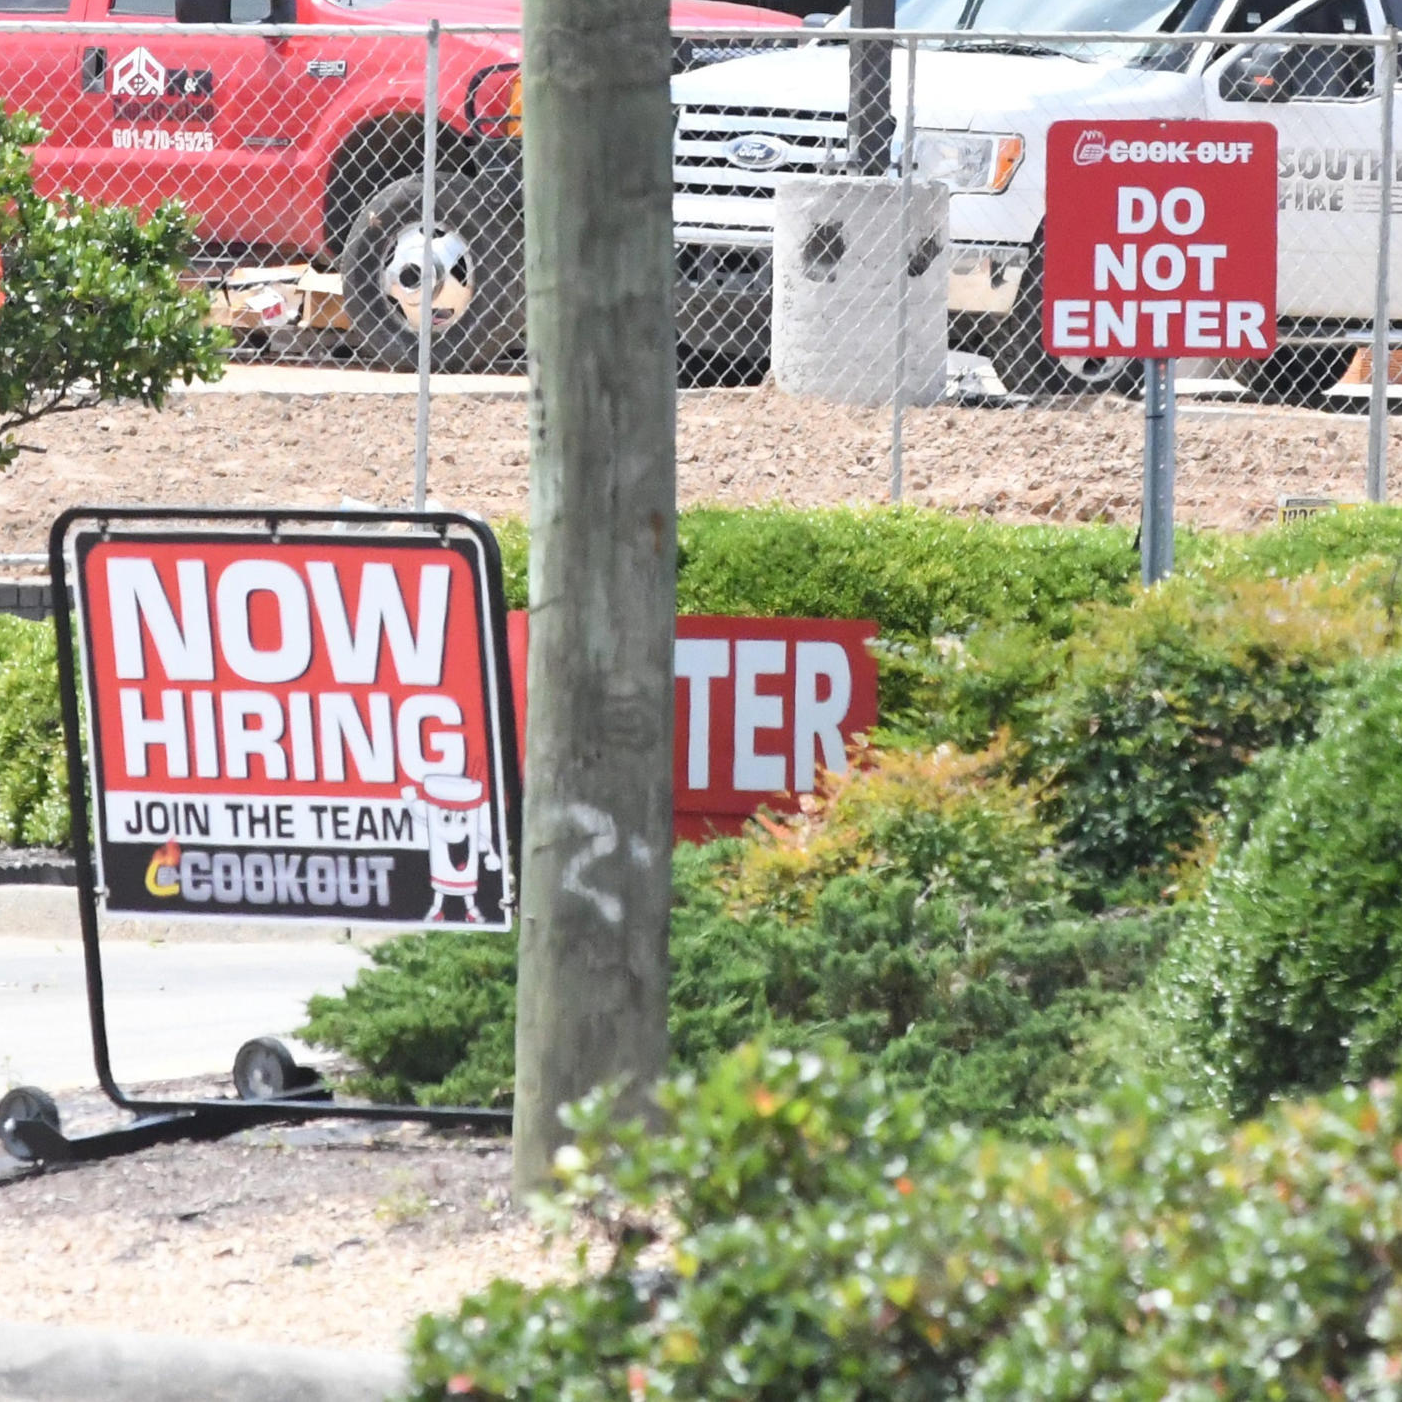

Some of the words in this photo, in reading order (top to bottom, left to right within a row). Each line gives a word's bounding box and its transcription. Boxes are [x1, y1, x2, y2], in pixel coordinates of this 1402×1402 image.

[112, 128, 214, 151] 601-270-5525
[1109, 140, 1190, 163] COOK
[1196, 141, 1253, 164] OUT
[1117, 186, 1205, 236] DO
[1094, 243, 1228, 292] NOT
[1052, 299, 1268, 349] ENTER
[104, 556, 452, 688] NOW
[117, 688, 466, 782] HIRING
[673, 638, 852, 792] TER
[124, 800, 210, 836] JOIN
[224, 803, 295, 840] THE
[309, 806, 414, 842] TEAM
